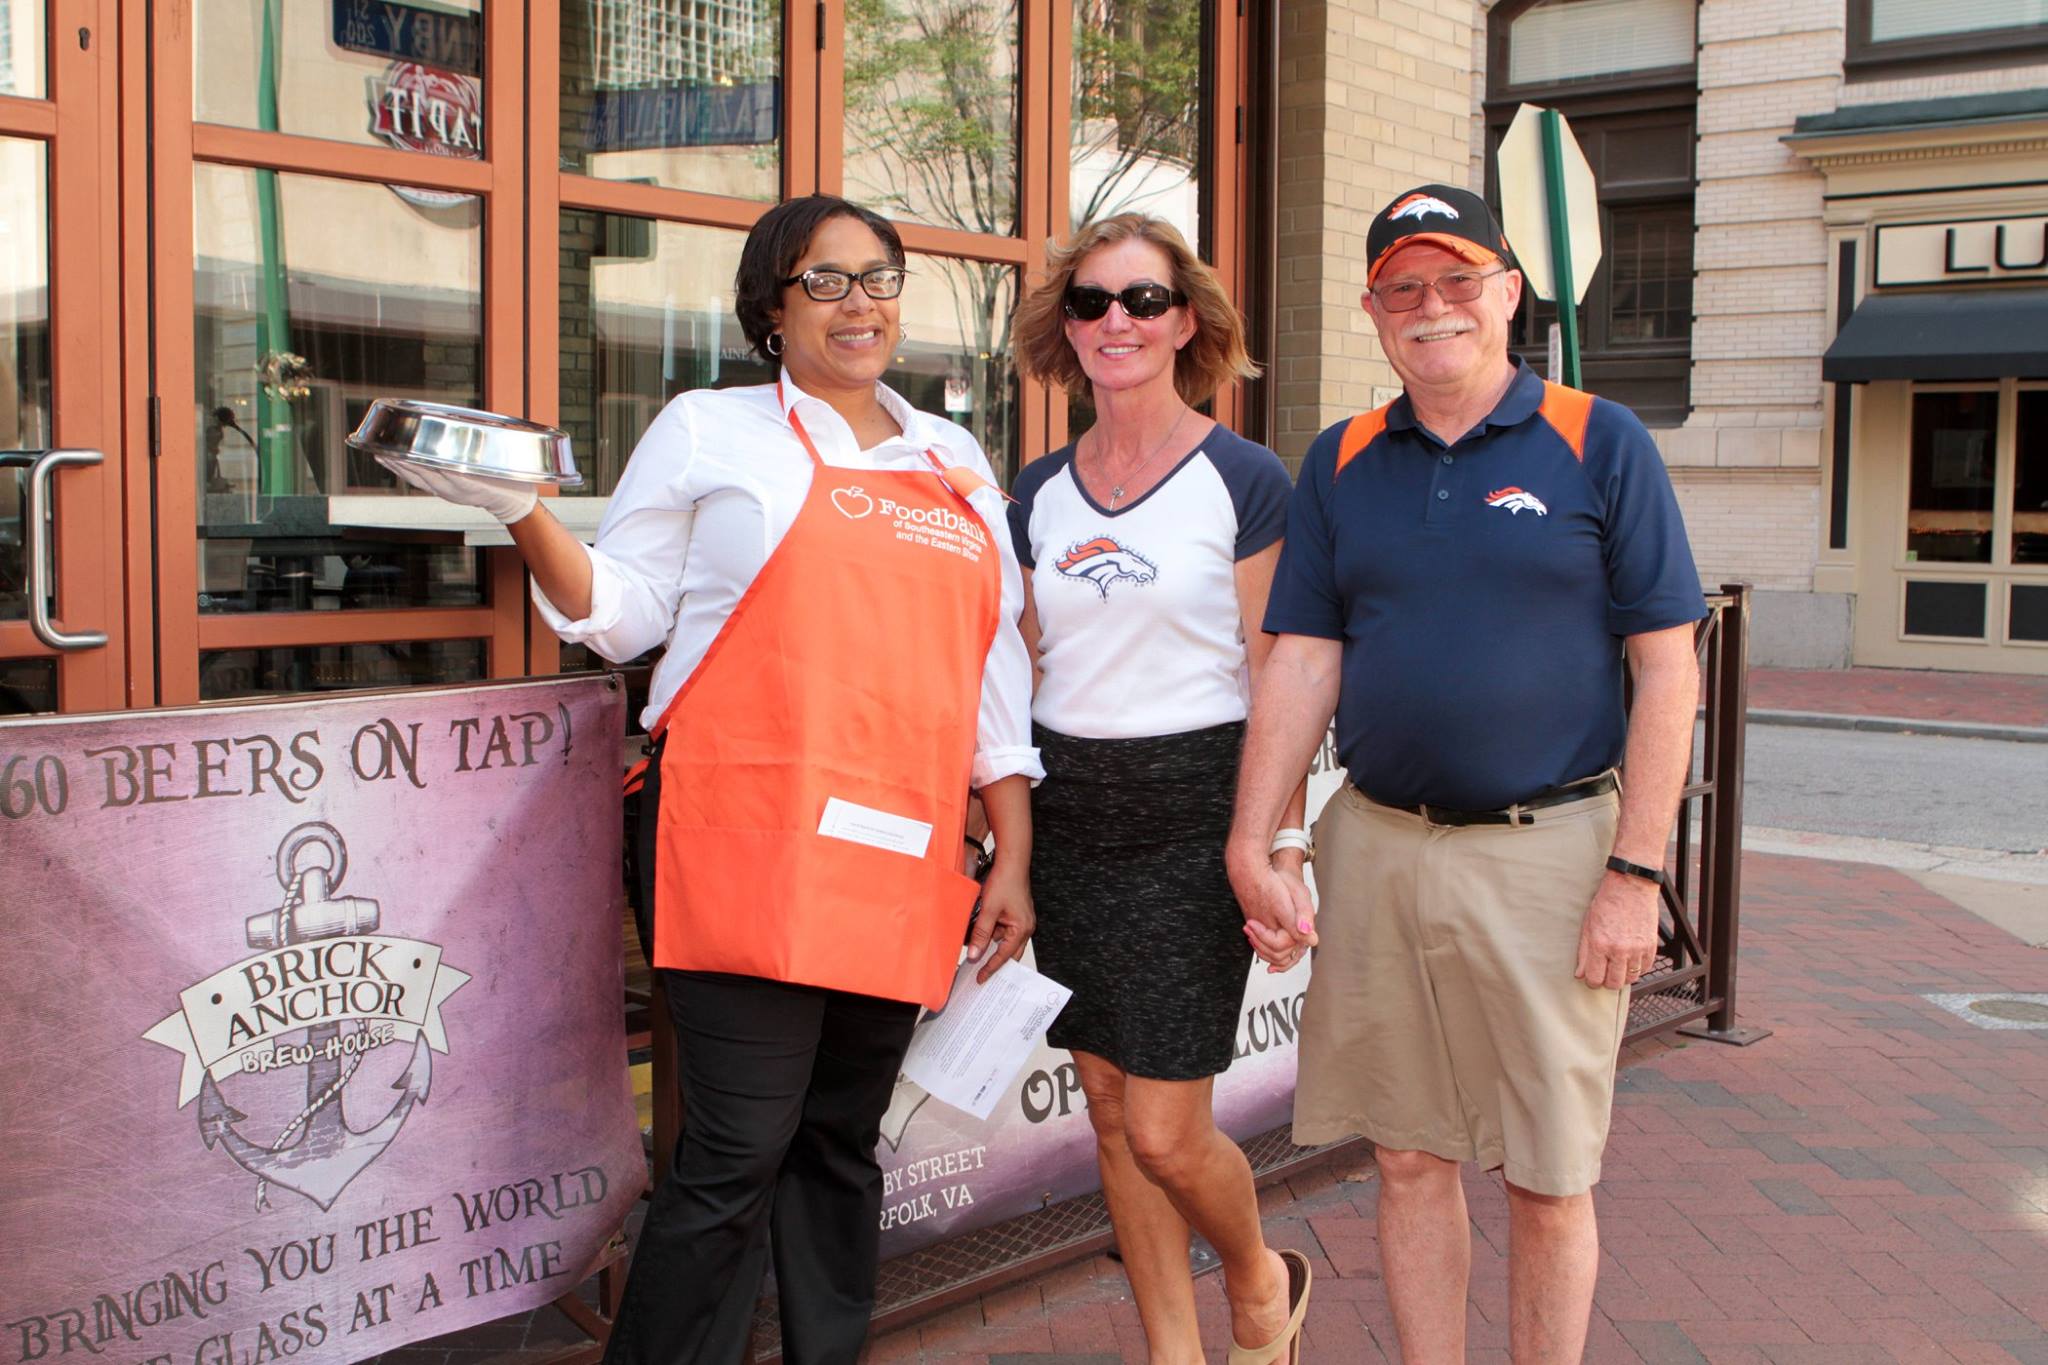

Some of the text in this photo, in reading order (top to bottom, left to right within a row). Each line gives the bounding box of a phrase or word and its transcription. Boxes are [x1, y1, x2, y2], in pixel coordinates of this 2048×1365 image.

[878, 497, 989, 547] Foodbank
[895, 531, 914, 542] and
[914, 533, 930, 546] the
[0, 754, 69, 820] 60
[84, 729, 325, 809] BEERS
[351, 717, 427, 788] ON
[239, 941, 393, 1003] BRICK
[227, 979, 406, 1050] ANCHOR
[240, 1023, 396, 1074] BREW-HOUSE
[1021, 1062, 1088, 1123] OP
[908, 1146, 986, 1187] STREET
[941, 1184, 974, 1209] VA
[6, 1166, 610, 1363] BRINGING YOU THE WORLD
[195, 1240, 571, 1365] GLASS AT A TIME
